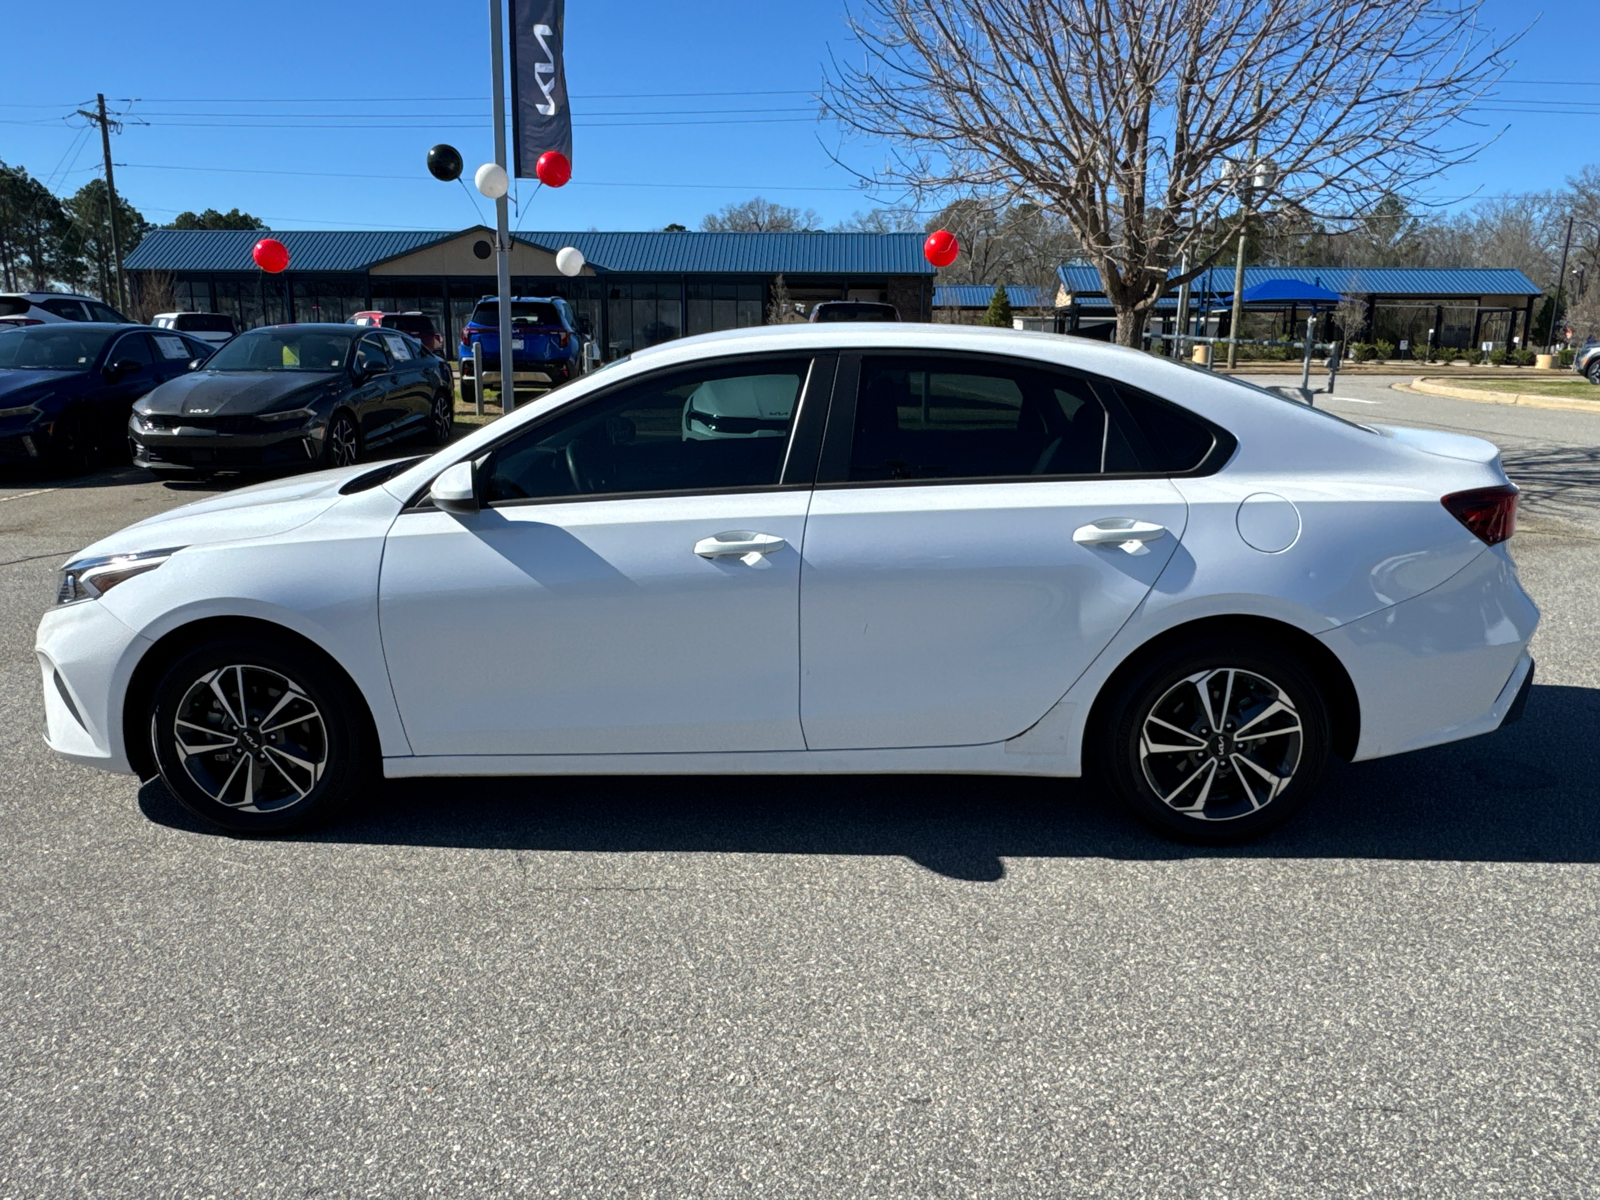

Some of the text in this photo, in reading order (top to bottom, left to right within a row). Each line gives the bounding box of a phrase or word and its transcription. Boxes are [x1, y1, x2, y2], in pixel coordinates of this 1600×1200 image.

[533, 24, 555, 116] KIA
[243, 731, 259, 748] KIA
[1217, 735, 1225, 756] KIA
